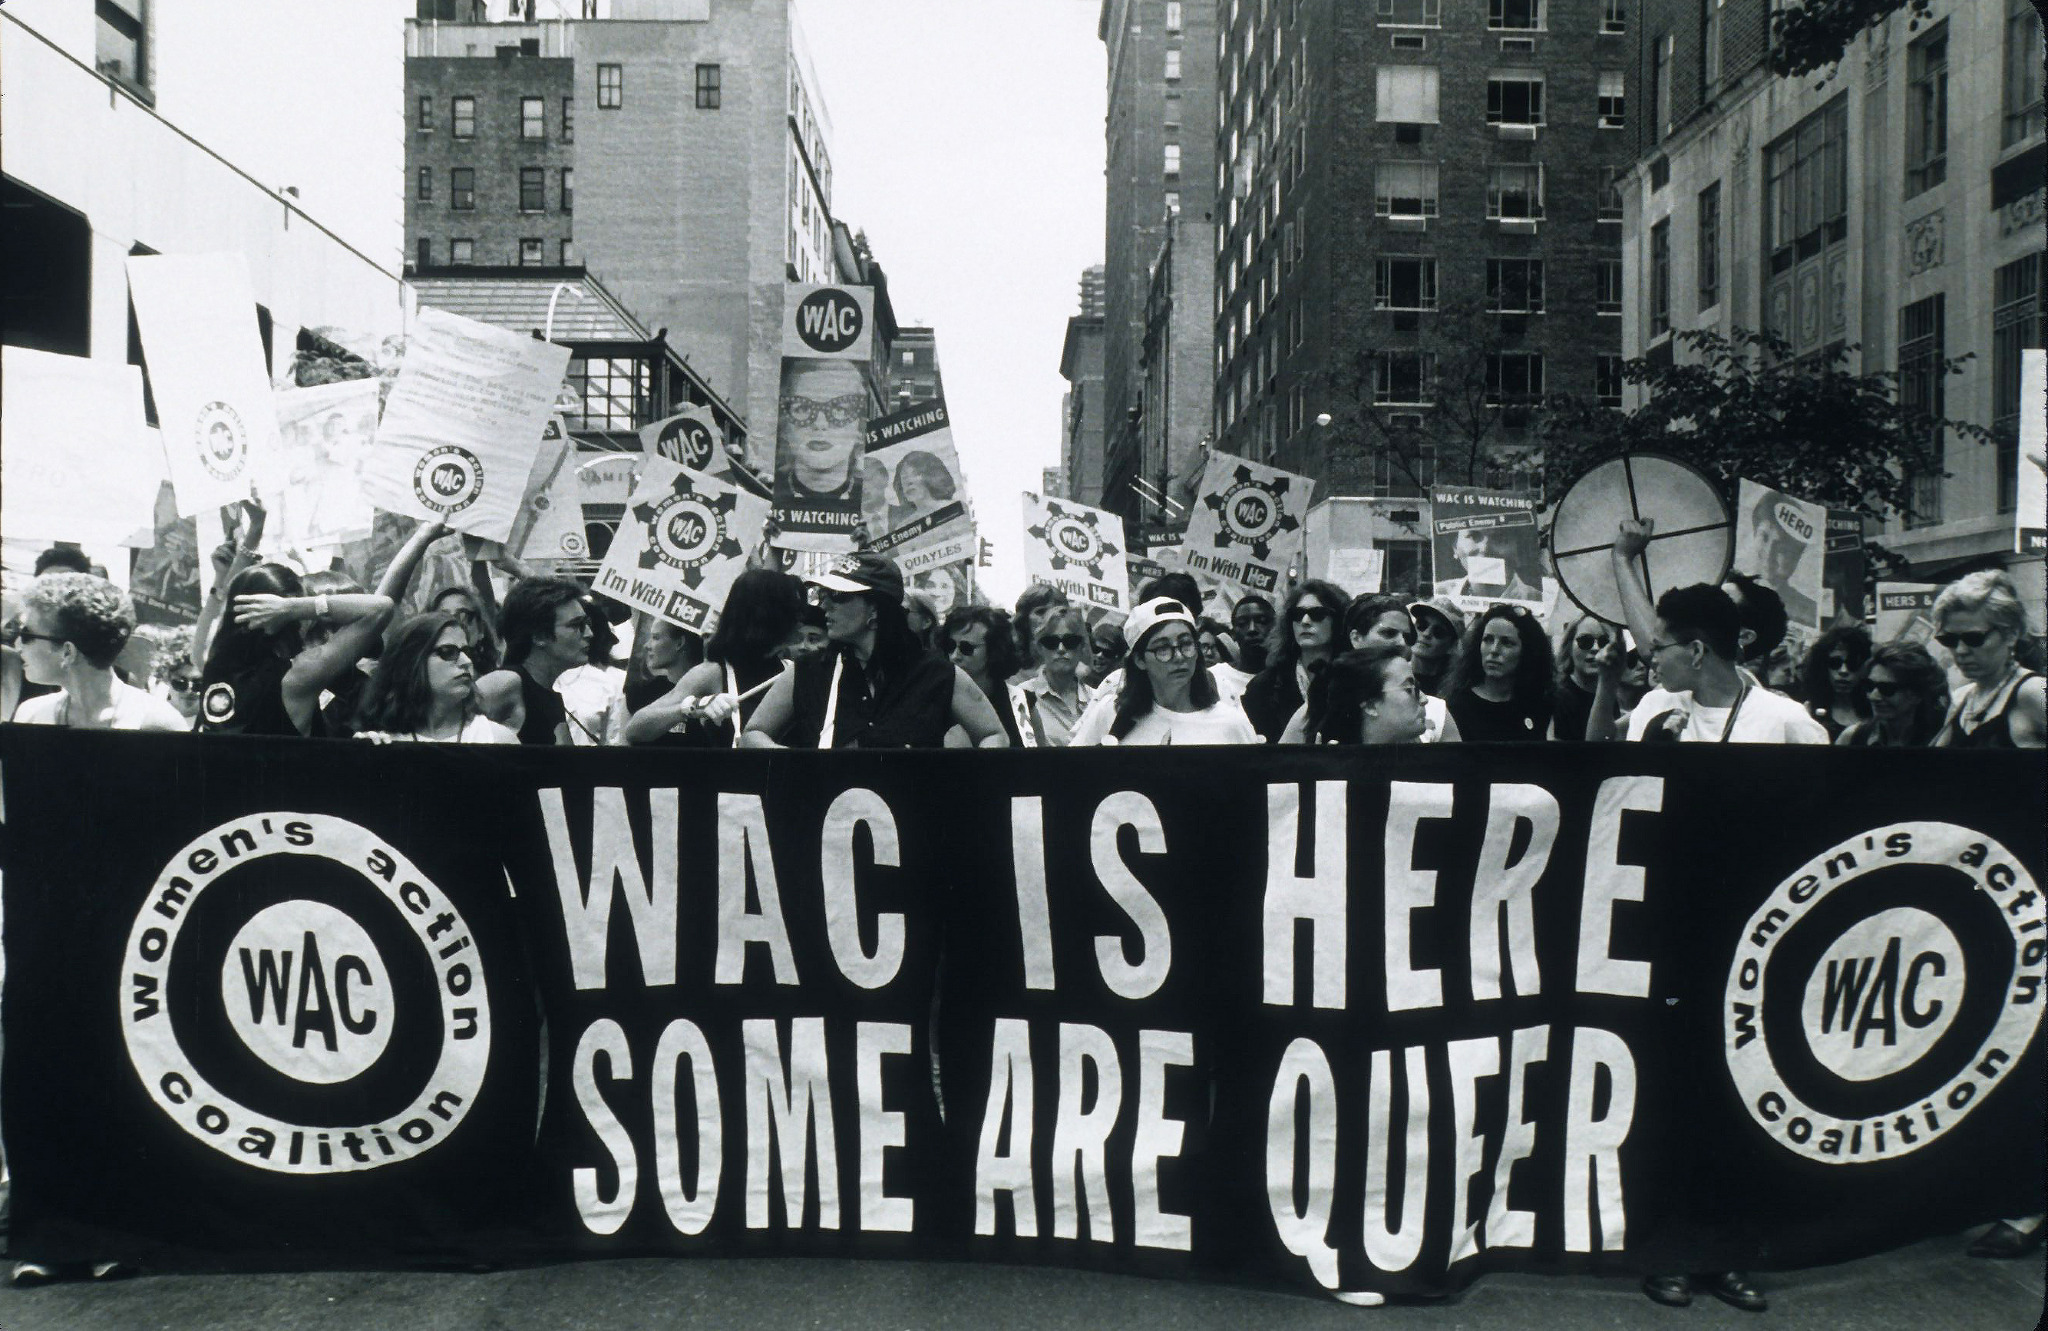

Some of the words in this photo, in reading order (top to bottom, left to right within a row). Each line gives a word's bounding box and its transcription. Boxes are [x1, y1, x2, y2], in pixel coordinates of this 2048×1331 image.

[803, 299, 856, 342] WAC
[865, 430, 878, 444] IS
[881, 407, 945, 439] WATCHING
[660, 428, 709, 466] WAC
[434, 467, 463, 492] WAC
[774, 508, 786, 522] IS
[790, 509, 859, 527] WATCHING
[1238, 502, 1265, 524] WAC
[1436, 493, 1460, 504] WAC
[1464, 494, 1475, 505] IS
[1478, 495, 1534, 510] WATCHING
[671, 517, 704, 544] WAC
[891, 523, 922, 544] Enemy
[1061, 530, 1088, 550] WAC
[1148, 533, 1166, 543] WAC
[1168, 532, 1177, 541] IS
[1778, 506, 1814, 540] HERO
[1827, 519, 1860, 531] TCHING
[904, 543, 962, 570] QUAYLES
[1186, 549, 1208, 569] I'm
[1211, 556, 1241, 580] With
[1246, 566, 1272, 588] Her
[602, 567, 628, 594] I'm
[629, 578, 666, 609] With
[670, 595, 702, 623] Her
[1056, 578, 1085, 597] With
[1092, 585, 1115, 605] Her
[1885, 595, 1917, 607] HERS
[537, 786, 906, 990] WAC
[1010, 789, 1172, 1000] IS
[1262, 775, 1665, 1012] HERE
[132, 818, 315, 1023] women's
[1958, 841, 2047, 1006] action
[366, 847, 479, 1041] action
[1732, 831, 1913, 1050] women's
[238, 930, 378, 1053] WAC
[1820, 935, 1947, 1050] WAC
[159, 1070, 464, 1167] coalition
[1757, 1047, 2011, 1157] coalition
[572, 1016, 914, 1235] SOME
[974, 1016, 1195, 1251] ARE
[1265, 1023, 1638, 1290] QUEER
